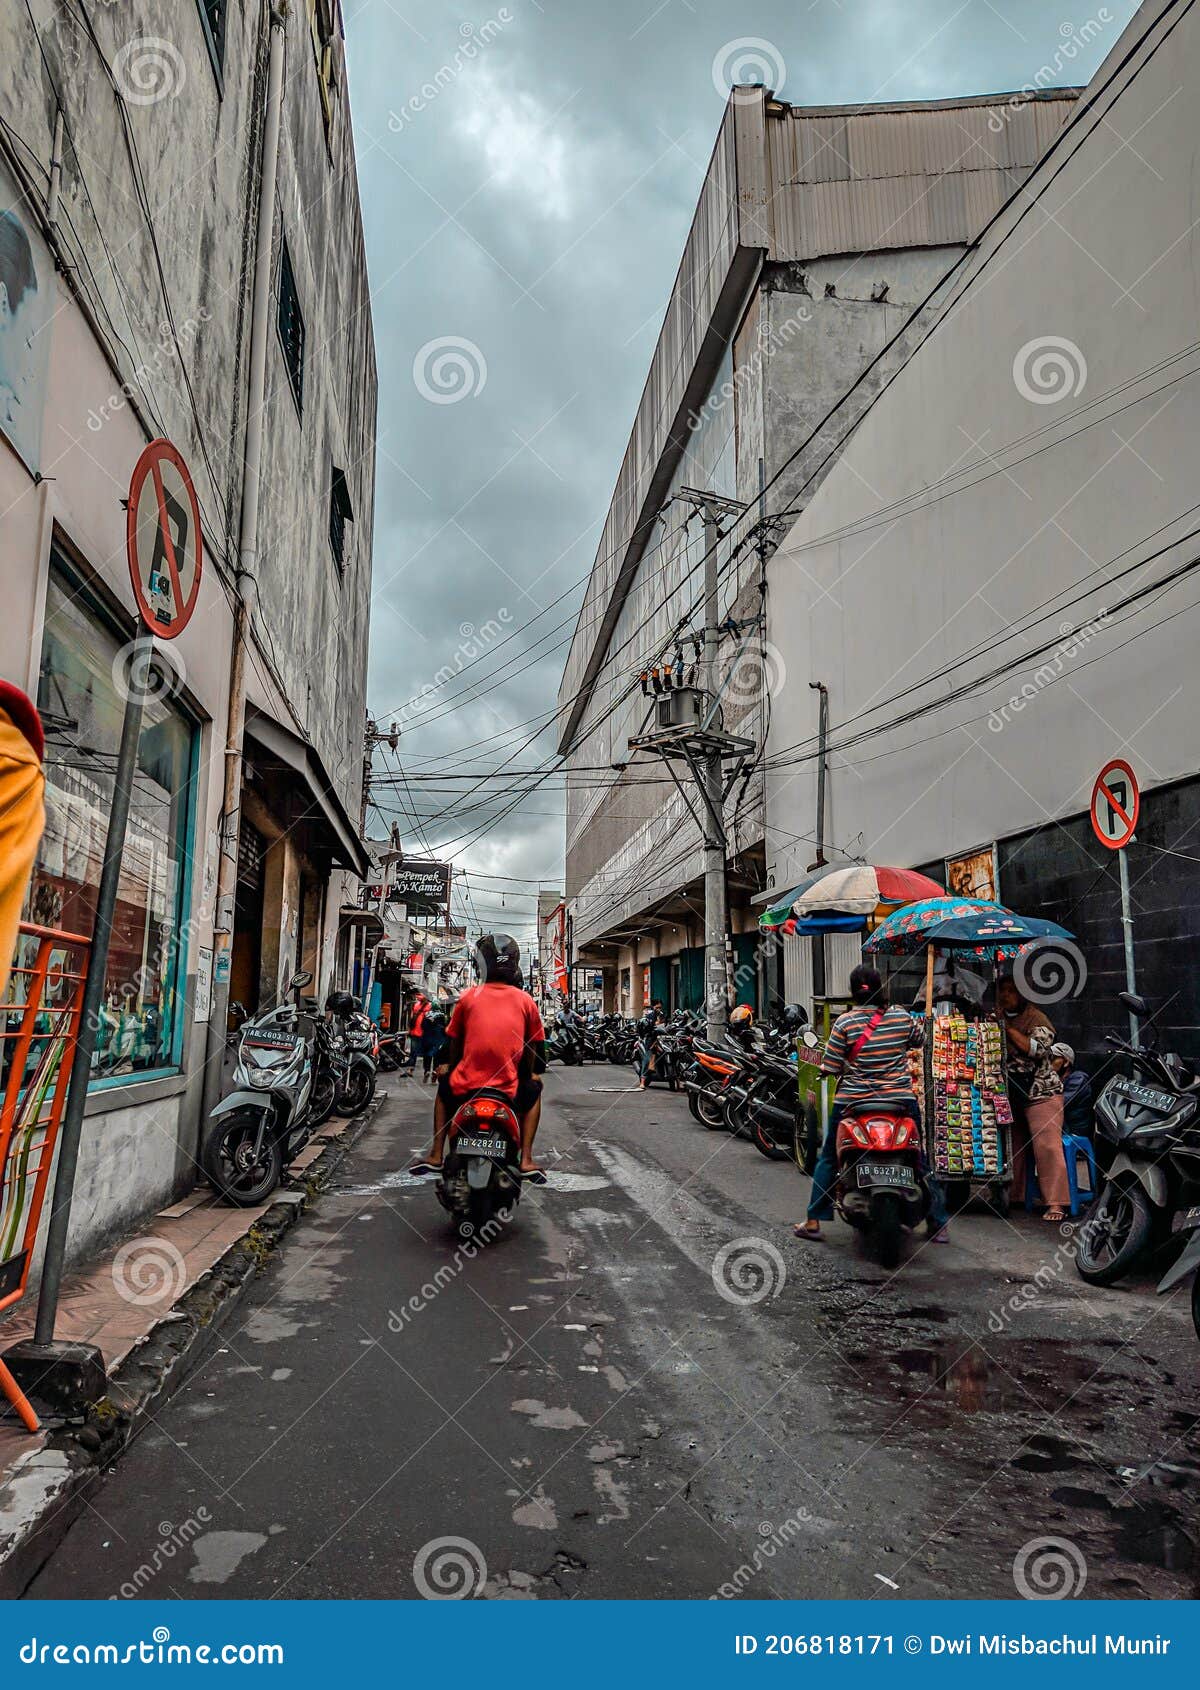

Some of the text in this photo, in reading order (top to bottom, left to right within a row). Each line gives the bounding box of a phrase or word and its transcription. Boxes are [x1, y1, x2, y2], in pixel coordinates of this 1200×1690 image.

[1107, 781, 1127, 835] P
[859, 1166, 870, 1175] AB
[873, 1166, 895, 1176] 6327
